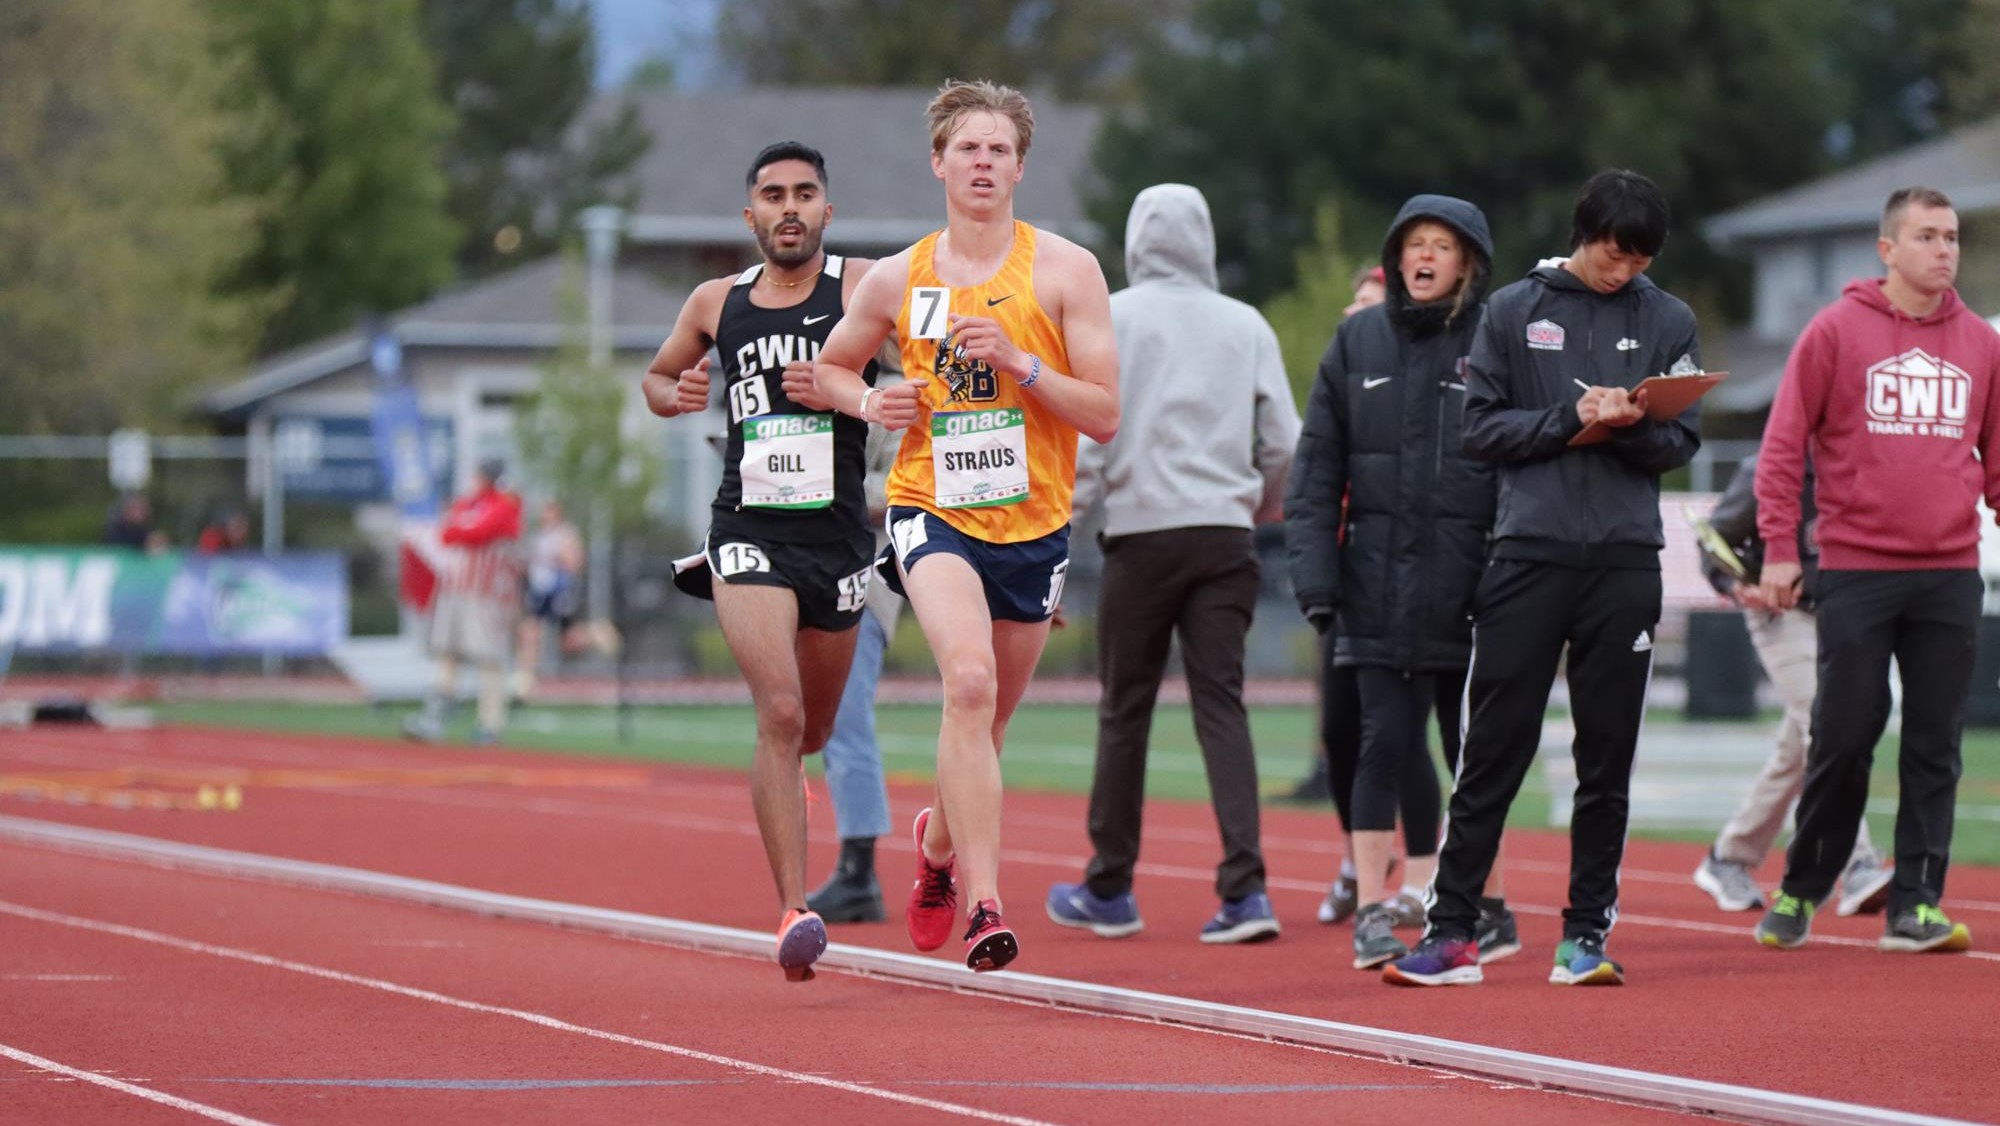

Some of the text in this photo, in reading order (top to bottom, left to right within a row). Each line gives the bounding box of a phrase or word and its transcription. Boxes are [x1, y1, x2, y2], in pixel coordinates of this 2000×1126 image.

[919, 290, 942, 336] 7
[967, 358, 998, 401] B
[734, 381, 760, 417] 15
[1871, 372, 1967, 419] CWU
[756, 415, 819, 441] gnac
[945, 409, 1009, 440] gnac
[1866, 420, 1914, 435] TRACK
[768, 454, 805, 473] GILL
[944, 448, 1016, 471] STRAUS
[727, 546, 761, 572] 15
